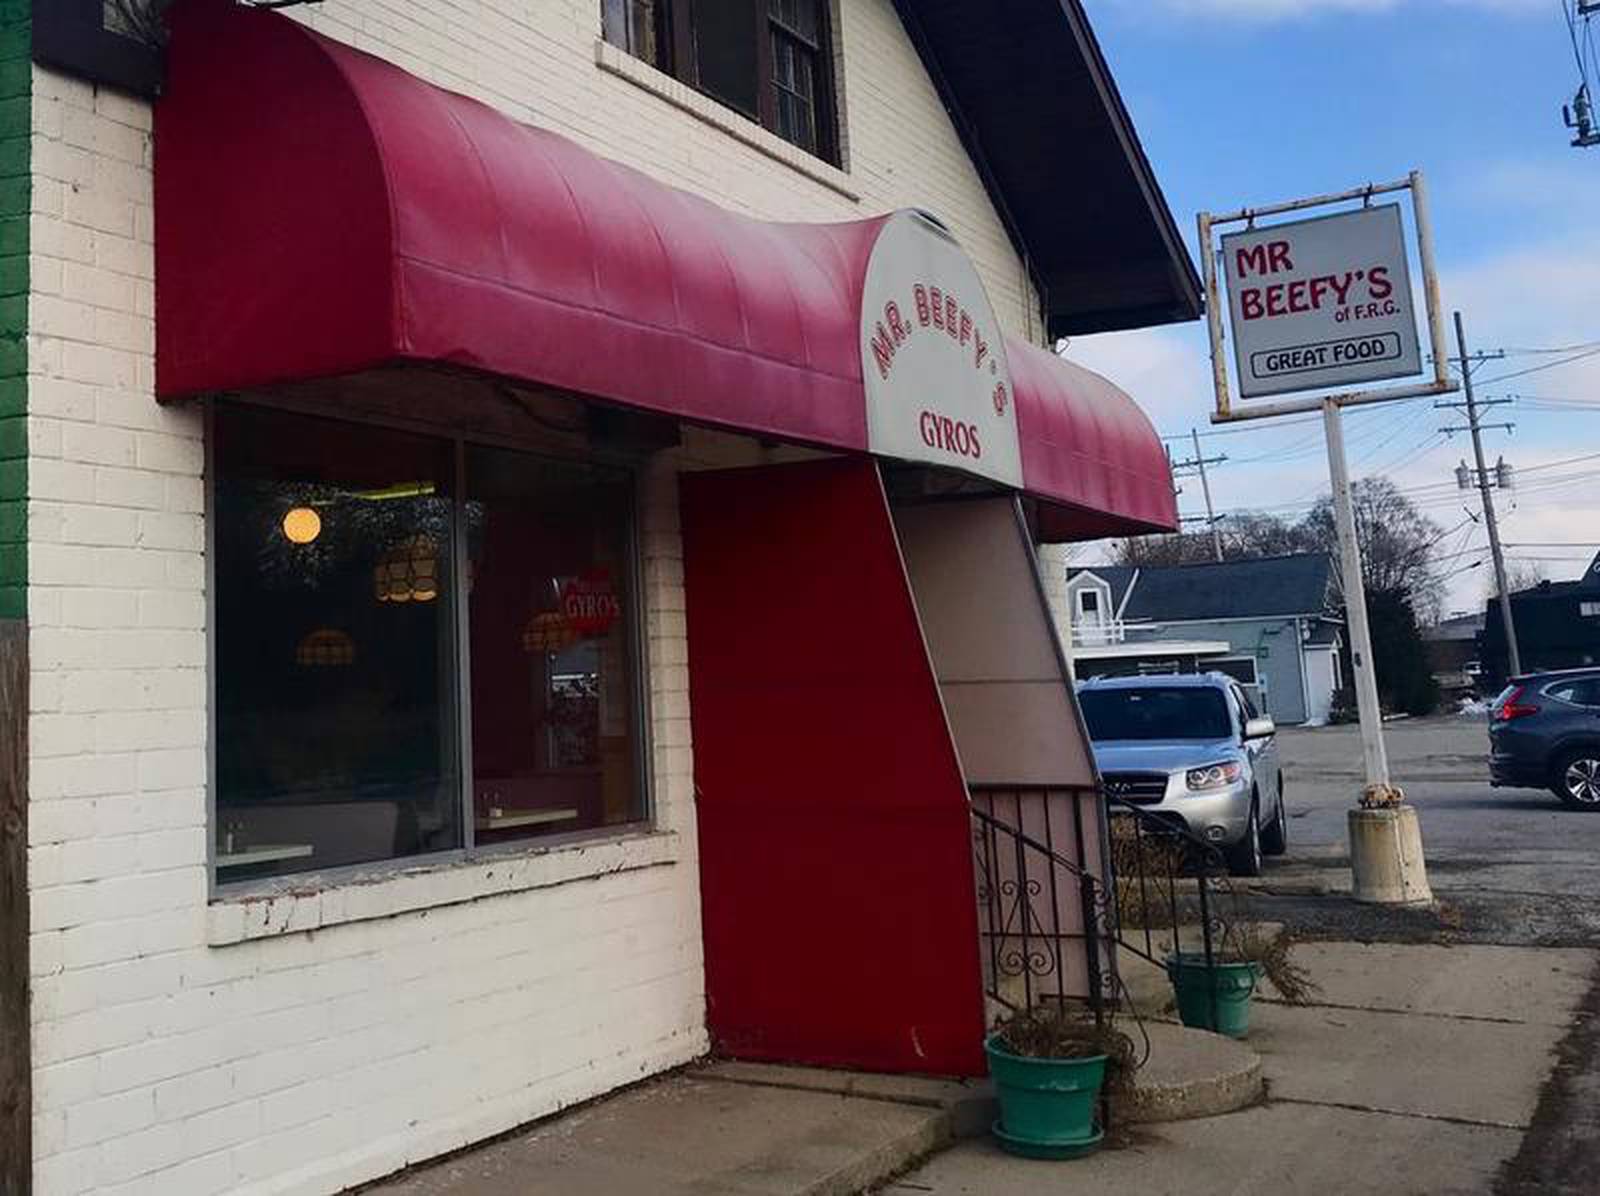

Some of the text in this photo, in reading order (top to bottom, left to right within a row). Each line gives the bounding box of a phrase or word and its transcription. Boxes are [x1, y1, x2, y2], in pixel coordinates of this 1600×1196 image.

[1236, 241, 1293, 278] MR
[1241, 267, 1392, 320] BEEFY'S
[1335, 300, 1401, 323] of F.R.G.
[870, 301, 912, 380] MR.
[1266, 339, 1385, 371] GREAT FOOD
[919, 411, 981, 458] GYROS
[565, 592, 619, 620] GYROS
